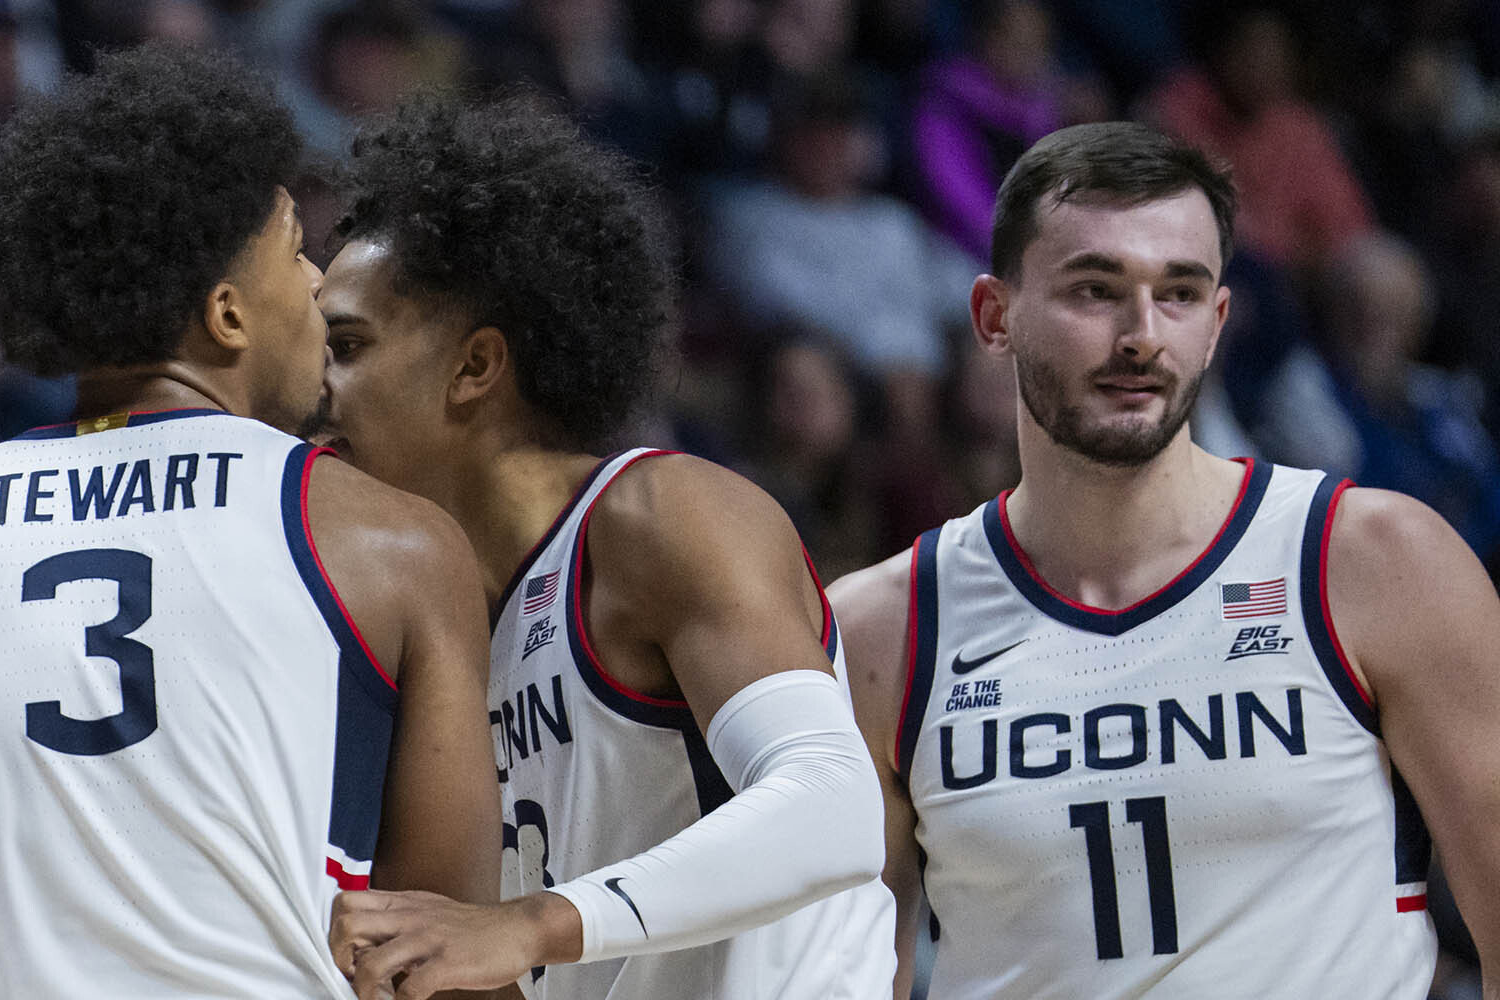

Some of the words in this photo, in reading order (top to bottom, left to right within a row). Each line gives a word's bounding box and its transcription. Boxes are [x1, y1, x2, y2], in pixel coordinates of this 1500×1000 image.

[528, 616, 550, 637] BIG
[1237, 626, 1280, 641] BIG
[524, 625, 557, 652] EAST
[1230, 638, 1293, 654] EAST
[22, 548, 157, 756] 3
[952, 682, 970, 696] BE
[974, 680, 1001, 694] THE
[946, 692, 1002, 711] CHANGE
[940, 688, 1307, 790] UCONN
[1069, 796, 1178, 960] 11
